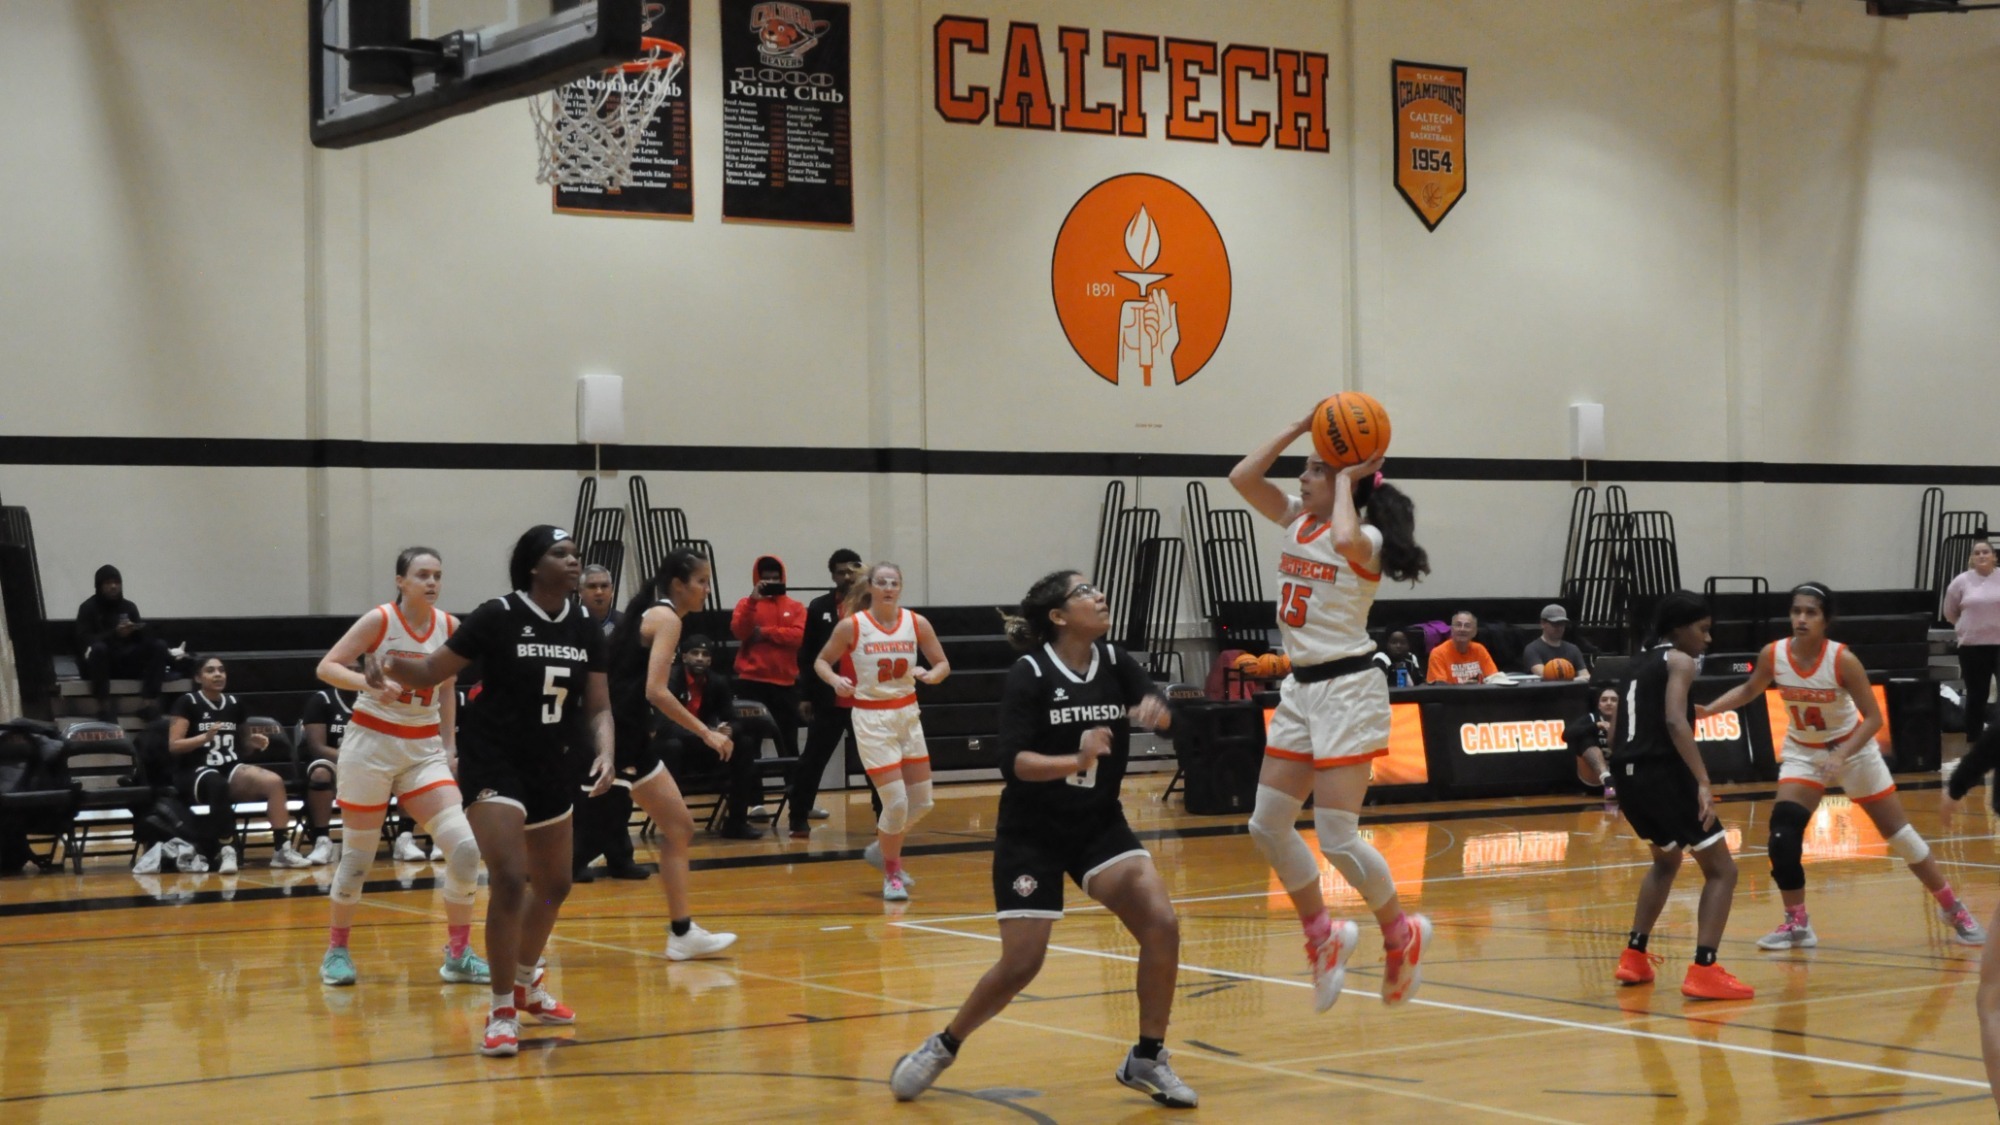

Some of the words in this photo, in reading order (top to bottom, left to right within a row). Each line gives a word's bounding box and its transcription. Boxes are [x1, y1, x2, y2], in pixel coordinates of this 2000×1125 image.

[761, 55, 803, 67] BEAVERS
[729, 80, 788, 99] Point
[793, 86, 844, 103] Club
[933, 14, 1330, 153] CALTECH
[1398, 80, 1463, 115] CHAMPIONS
[1410, 111, 1453, 124] CALTECH
[1412, 148, 1453, 173] 1954
[1086, 283, 1115, 297] 1891
[1325, 405, 1349, 456] Wilson
[1279, 582, 1313, 628] 15
[517, 643, 588, 662] BETHESDA
[877, 657, 909, 684] 20
[541, 665, 571, 724] 5
[1049, 704, 1127, 725] BETHESDA
[1626, 679, 1637, 742] 1
[1789, 704, 1827, 731] 14
[1460, 719, 1568, 755] CALTECH
